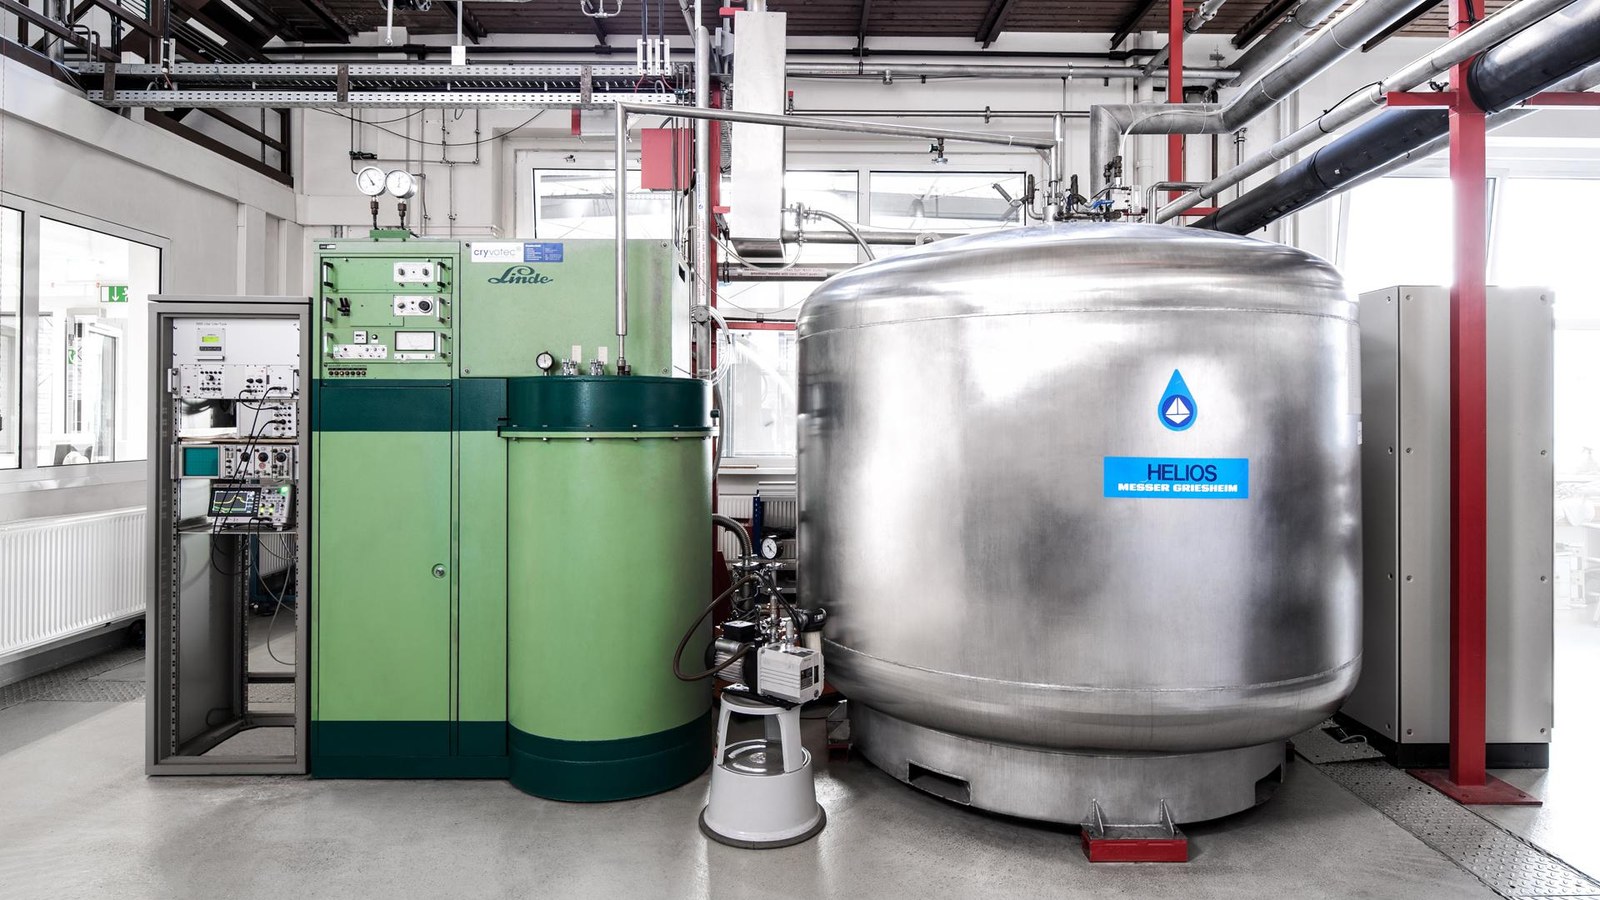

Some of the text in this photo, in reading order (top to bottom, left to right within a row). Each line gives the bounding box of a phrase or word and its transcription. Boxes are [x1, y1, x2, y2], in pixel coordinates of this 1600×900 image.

[487, 265, 554, 284] Linde
[1147, 463, 1218, 482] HELIOS
[1118, 482, 1238, 493] MESSER GRIESHEIM
